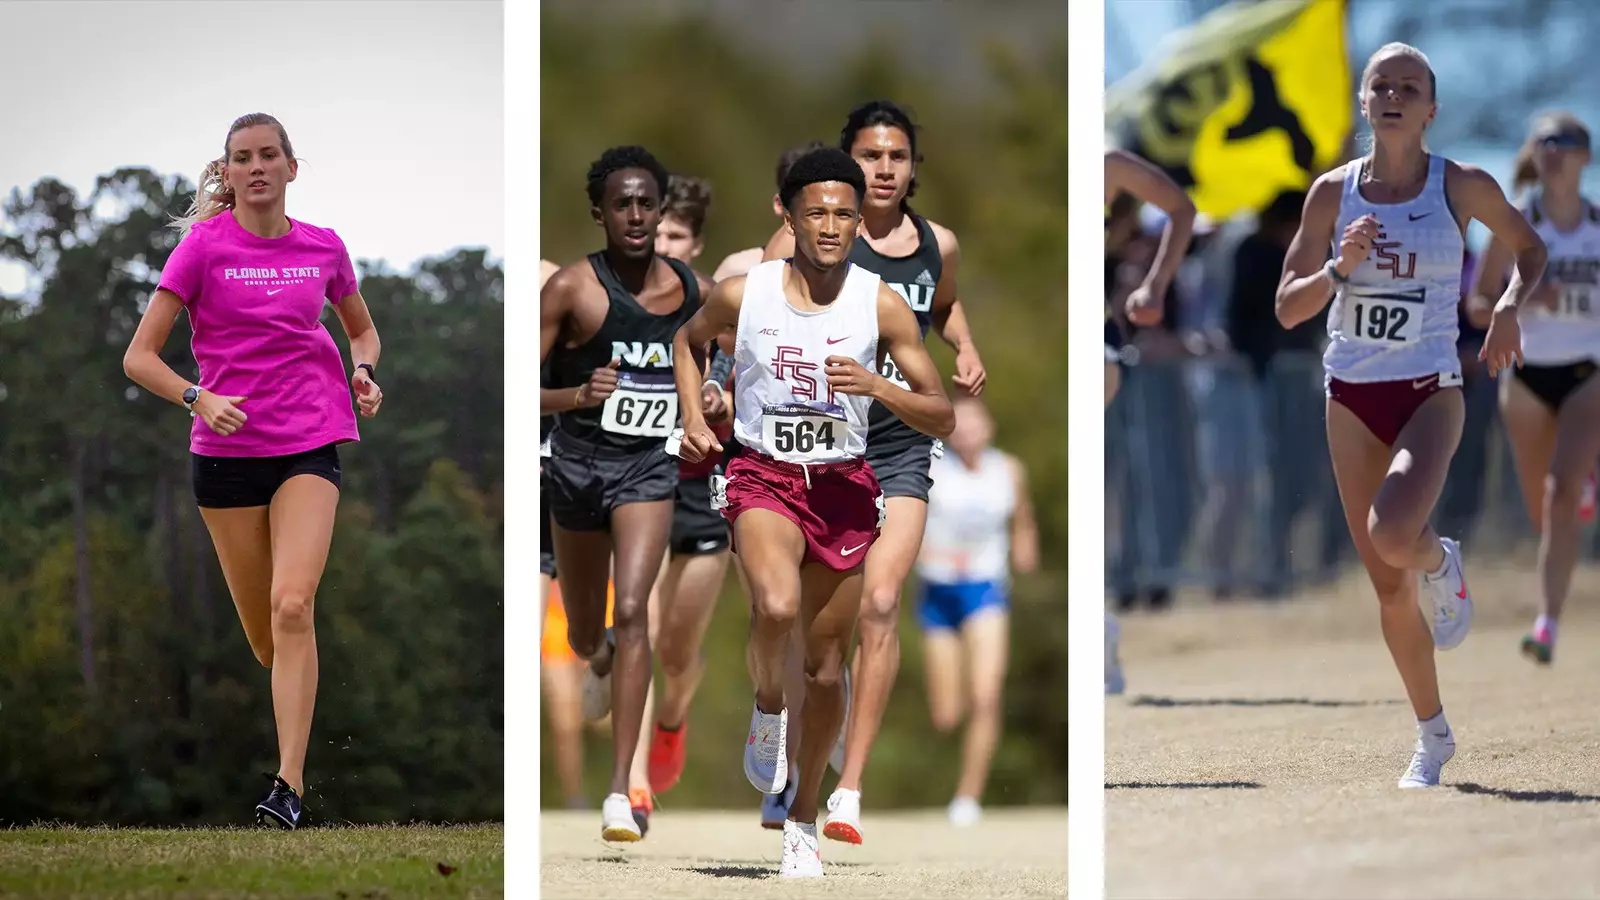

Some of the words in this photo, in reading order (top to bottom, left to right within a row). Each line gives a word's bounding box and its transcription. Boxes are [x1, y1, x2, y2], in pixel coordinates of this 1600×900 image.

[224, 267, 279, 279] FLORIDA
[282, 266, 320, 278] STATE
[757, 328, 780, 337] ACC
[1354, 303, 1410, 341] 192
[615, 396, 669, 429] 672
[774, 420, 835, 453] 564
